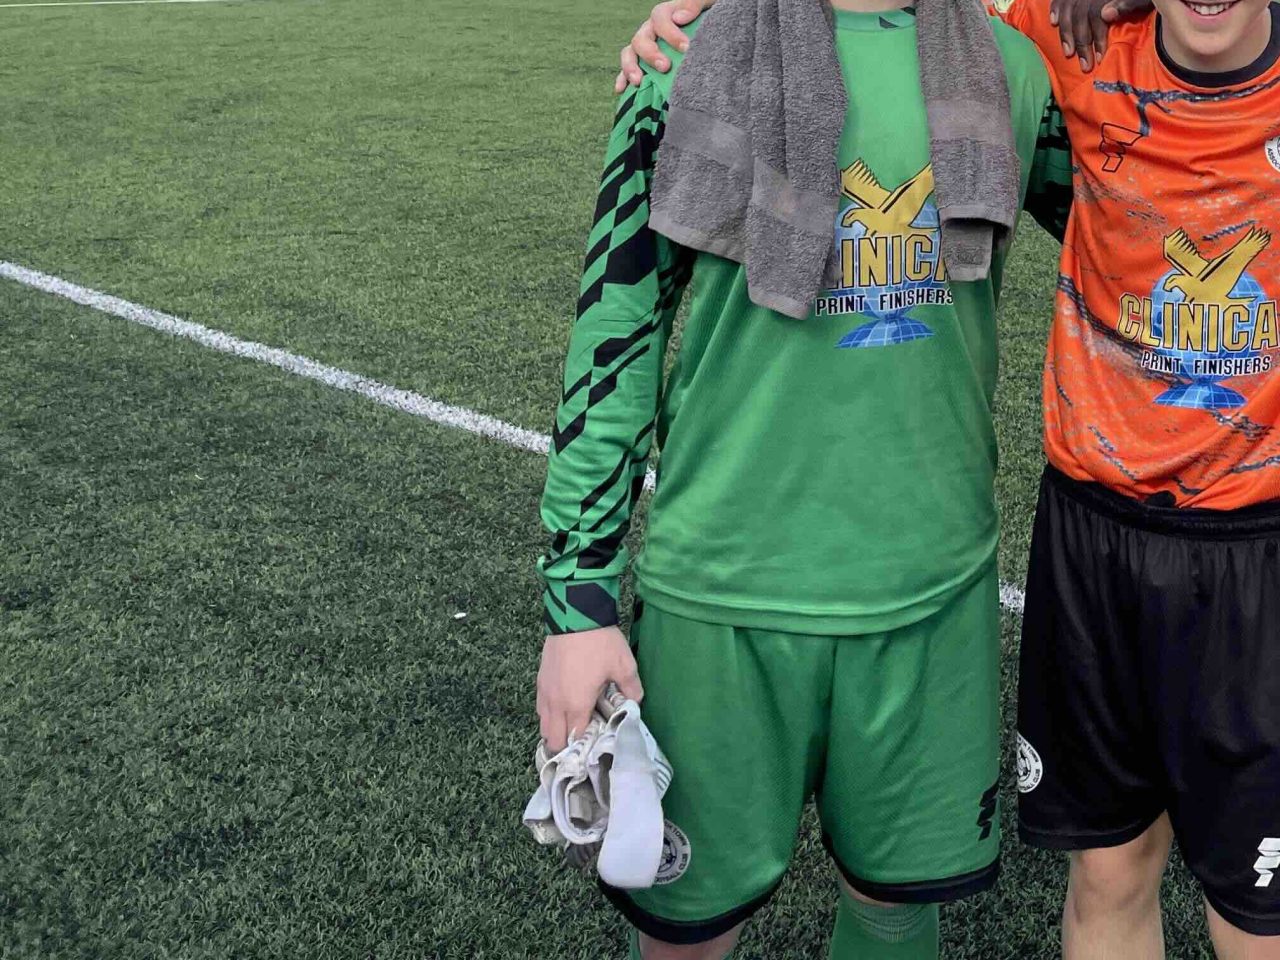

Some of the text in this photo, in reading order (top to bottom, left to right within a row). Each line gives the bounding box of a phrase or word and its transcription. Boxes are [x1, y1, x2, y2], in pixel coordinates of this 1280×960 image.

[816, 288, 953, 316] PRINT FINISHERS
[1141, 351, 1272, 376] PRINT FINISHERS
